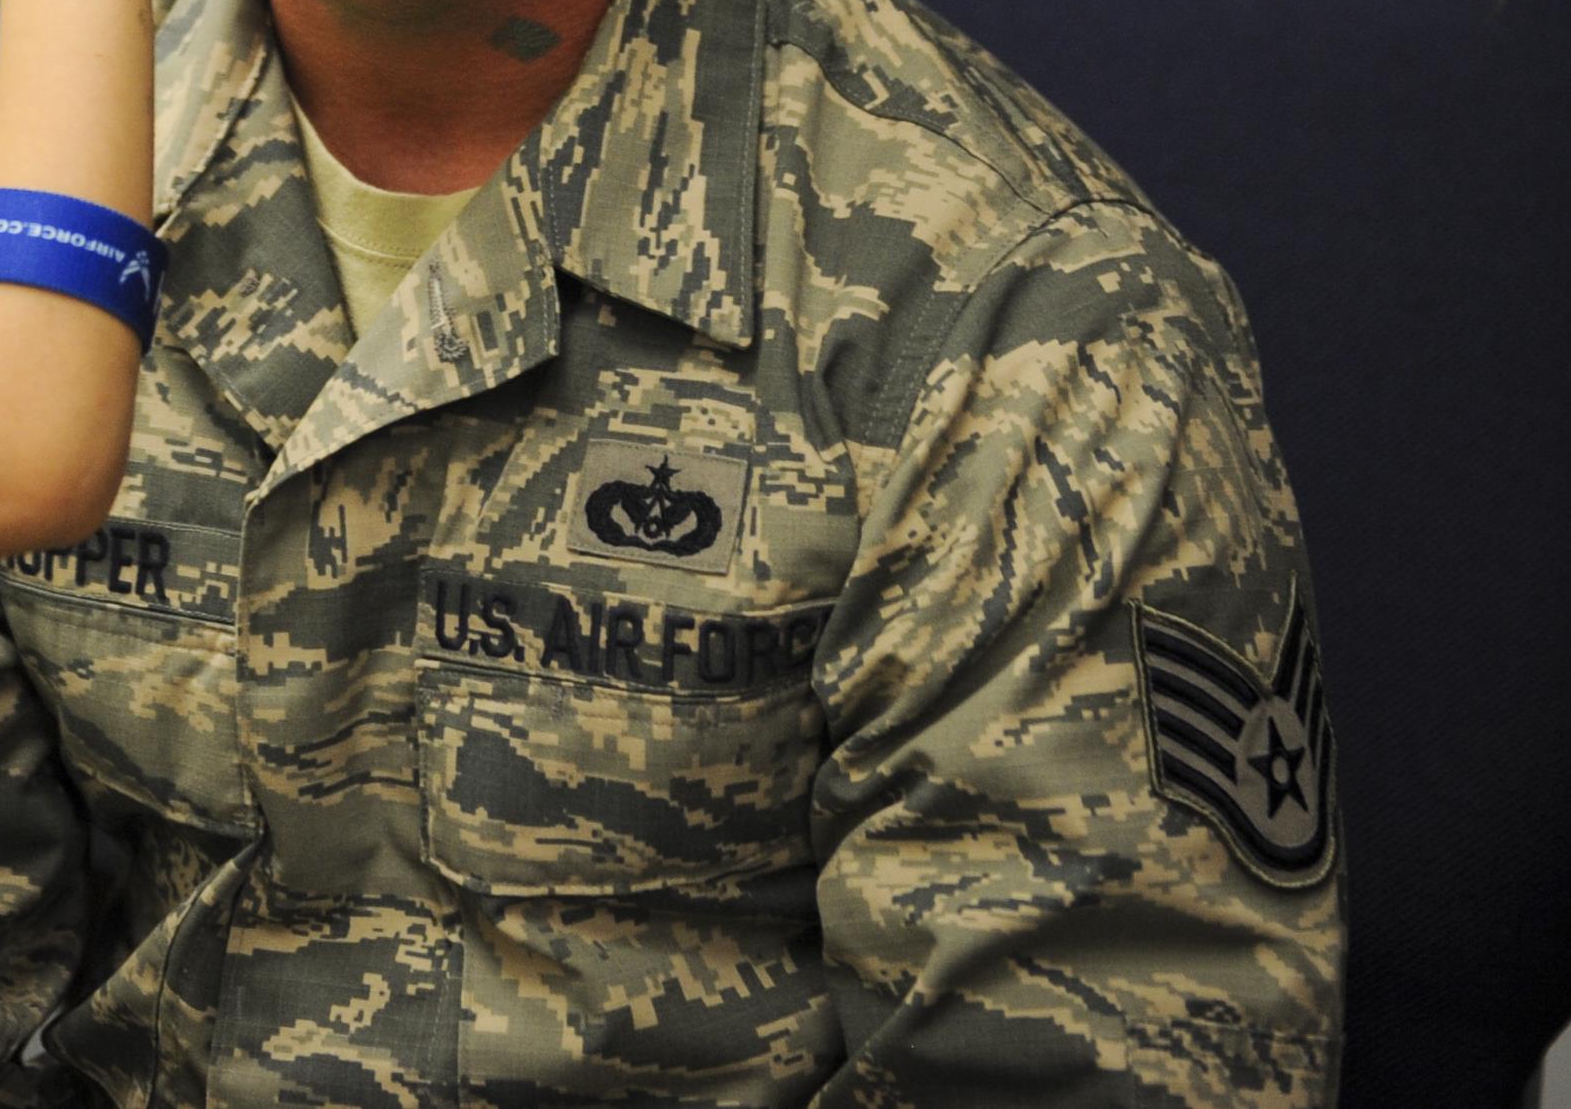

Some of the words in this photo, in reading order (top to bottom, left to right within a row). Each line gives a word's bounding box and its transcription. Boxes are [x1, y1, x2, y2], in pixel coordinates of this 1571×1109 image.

[434, 580, 525, 663] U.S.
[540, 592, 646, 682] AIR
[660, 603, 831, 690] FORC
